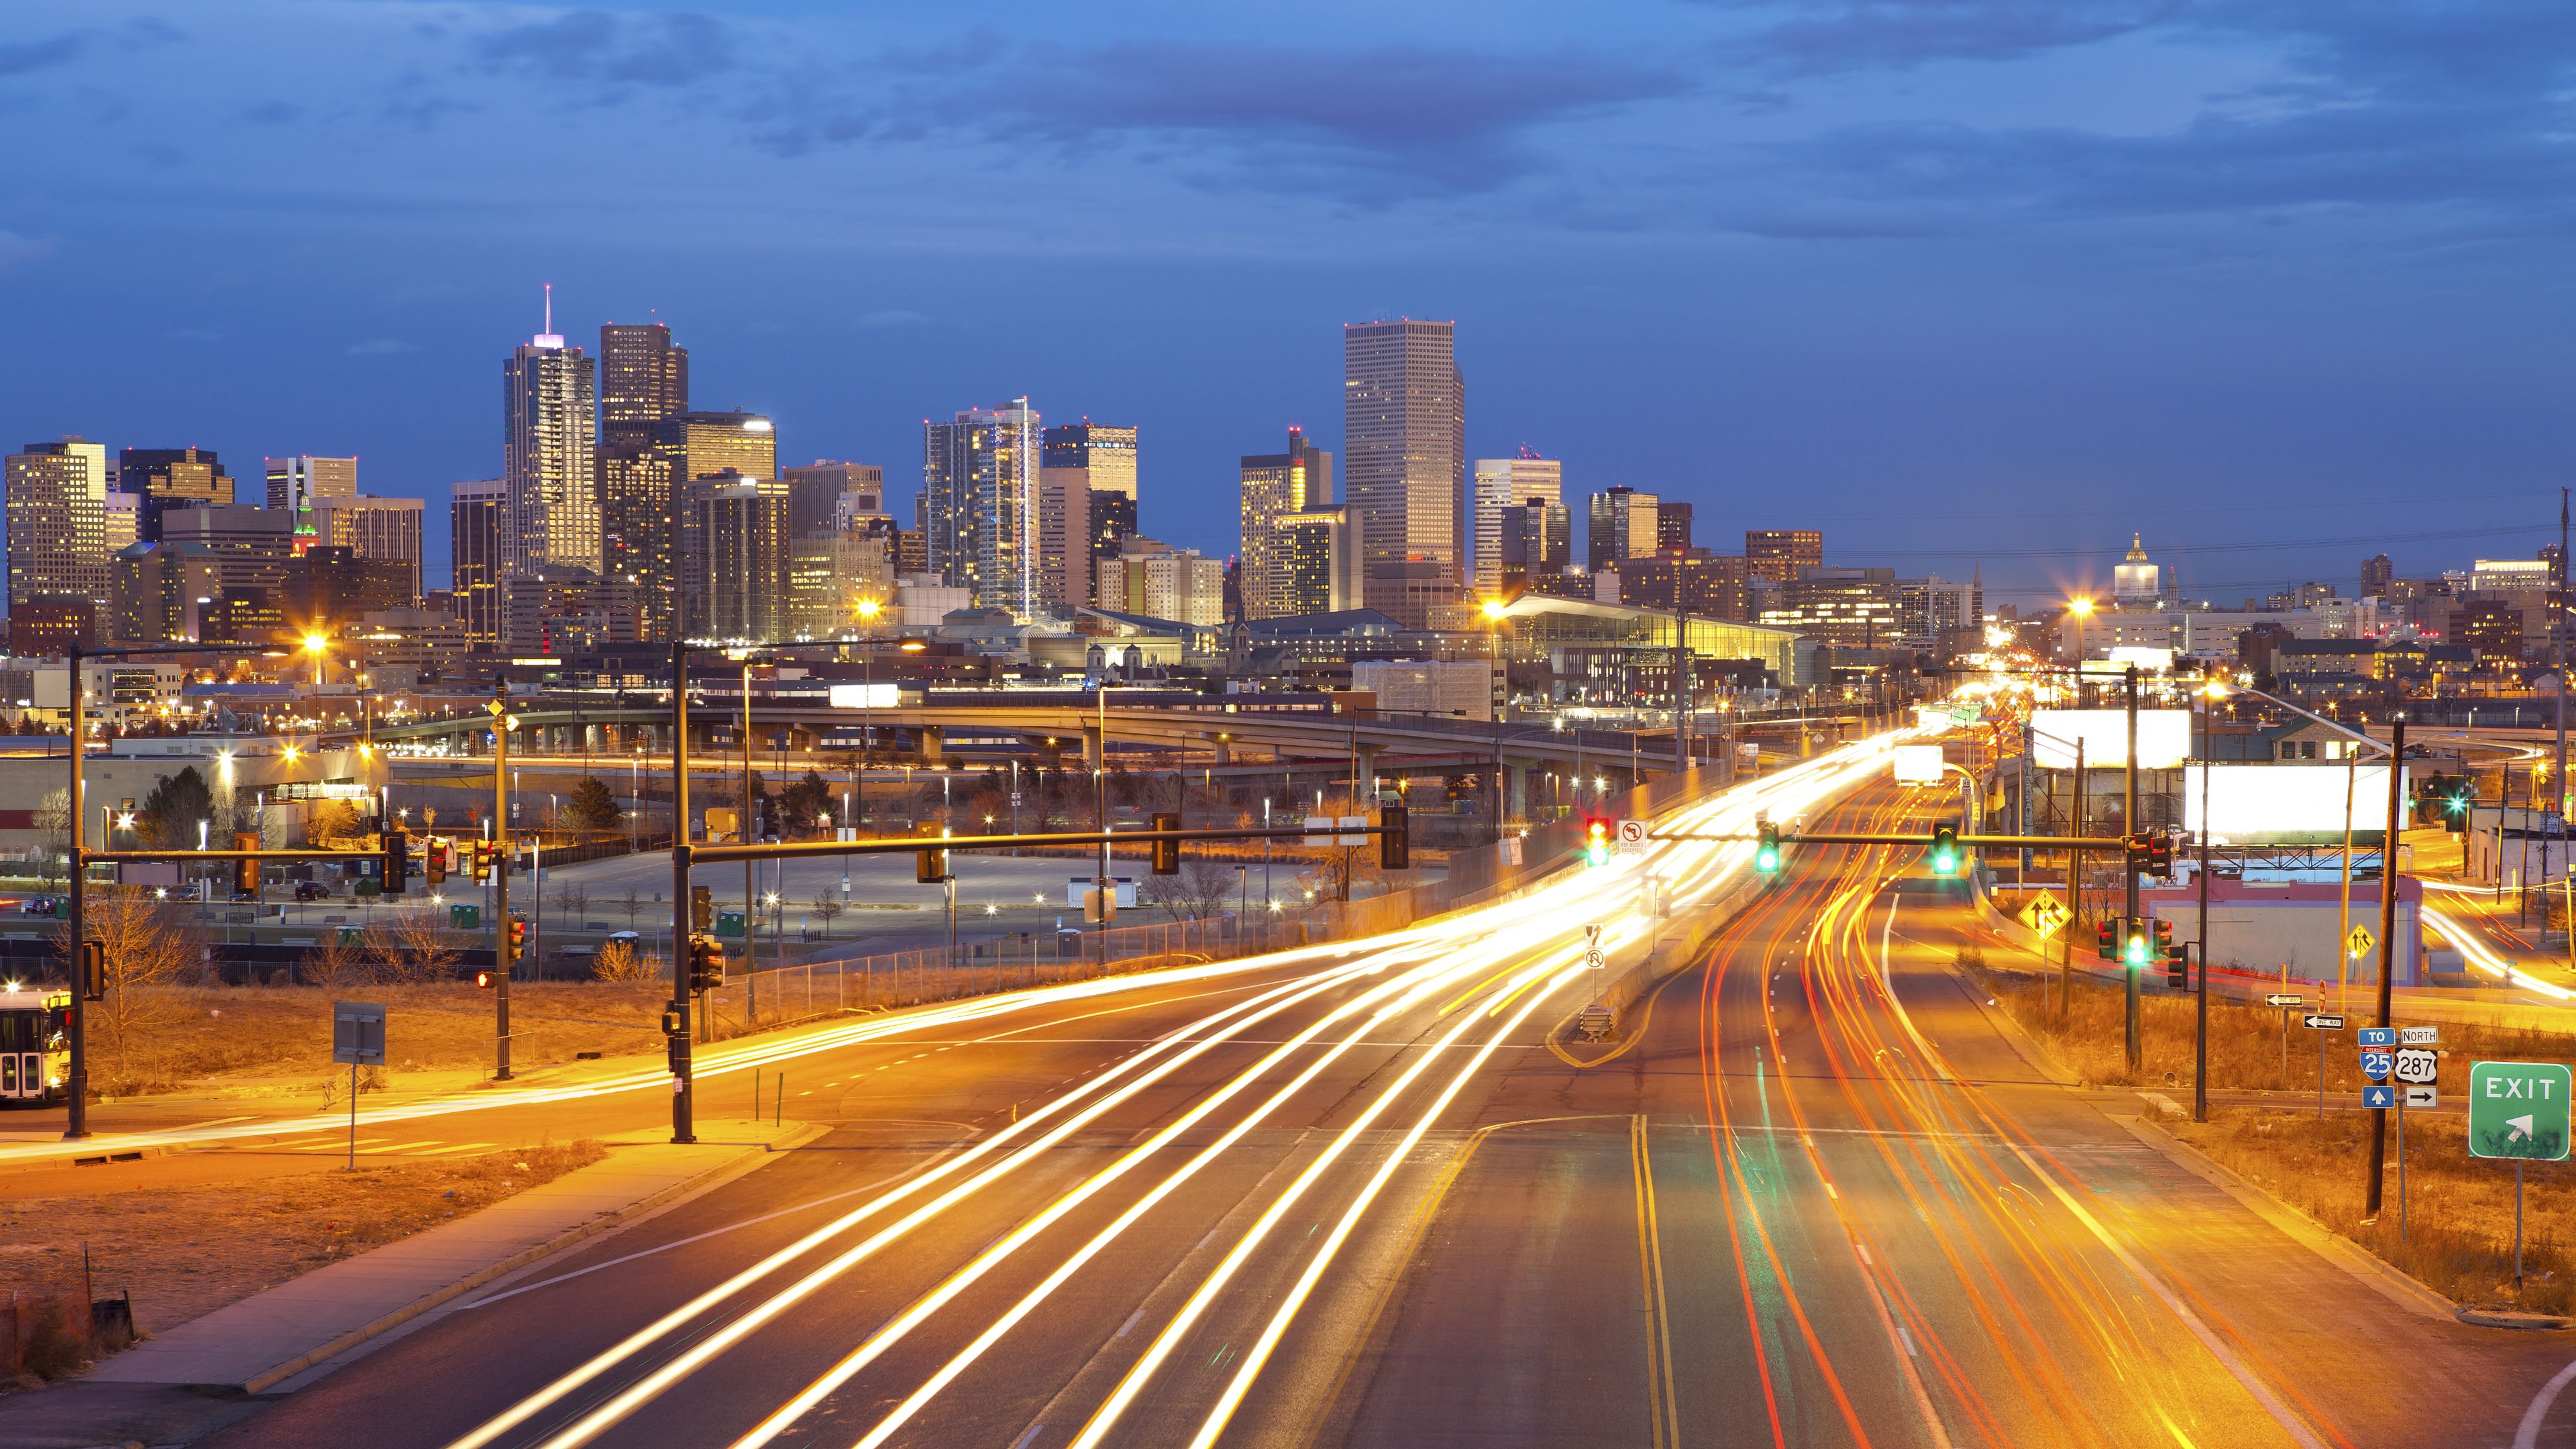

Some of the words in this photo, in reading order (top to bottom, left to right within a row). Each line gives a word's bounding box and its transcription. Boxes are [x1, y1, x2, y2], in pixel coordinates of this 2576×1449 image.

[2368, 1032, 2385, 1042] TO
[2403, 1030, 2436, 1041] NORTH
[2365, 1054, 2391, 1073] 25
[2400, 1057, 2432, 1077] 287
[2486, 1077, 2555, 1099] EXIT
